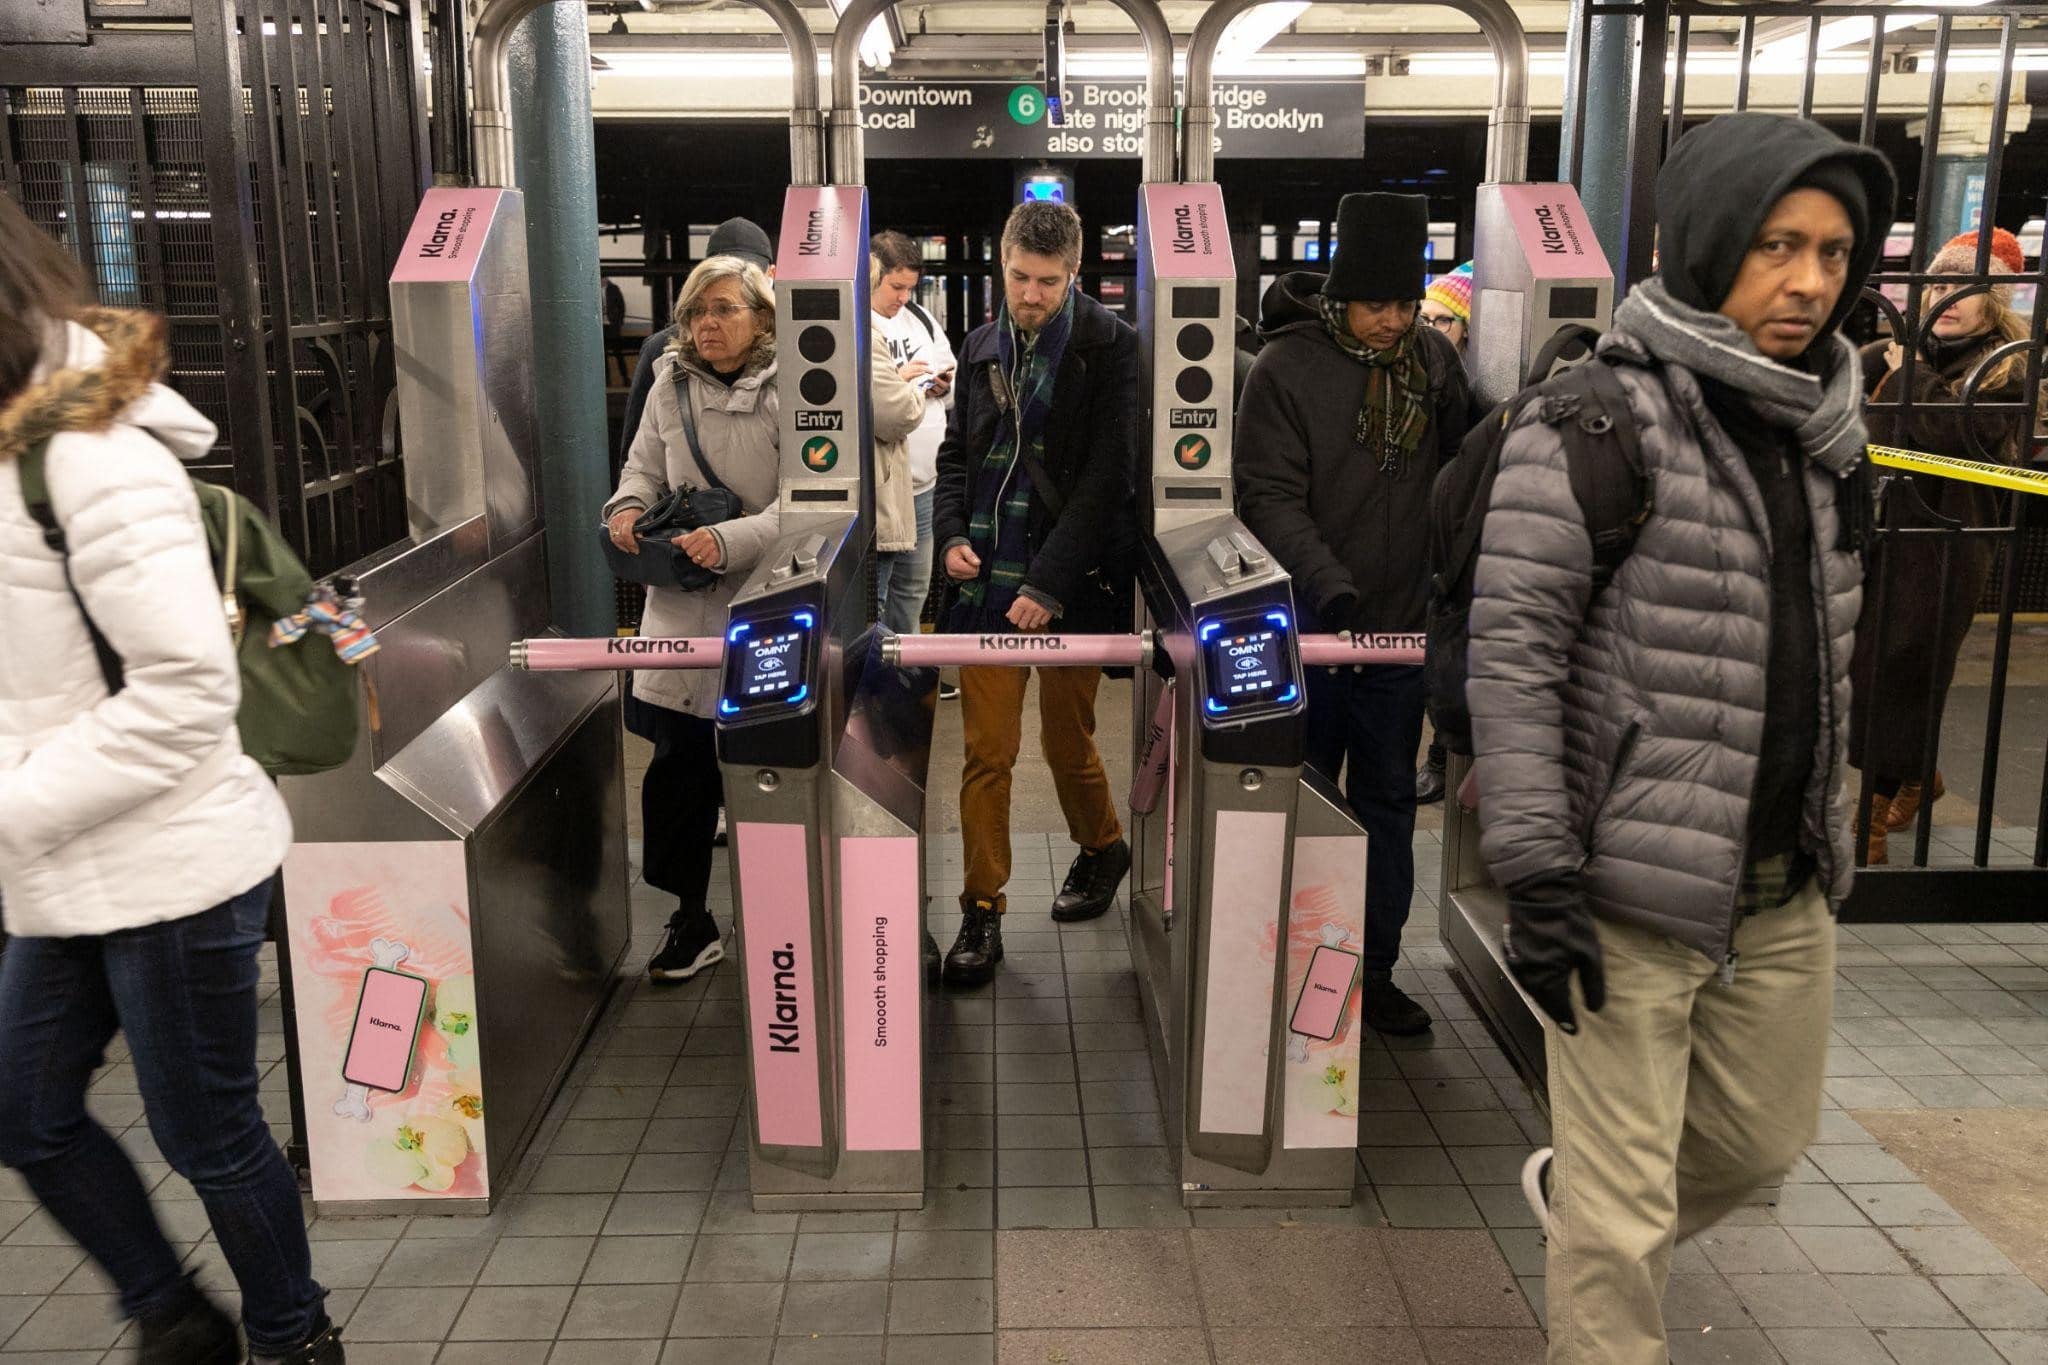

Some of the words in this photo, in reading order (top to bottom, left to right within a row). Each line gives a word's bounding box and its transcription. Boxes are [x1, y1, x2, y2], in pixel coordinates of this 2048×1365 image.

[860, 84, 972, 105] Downtown
[1018, 94, 1035, 117] 6
[1084, 85, 1182, 105] Brookn
[1211, 84, 1267, 110] ridge
[1227, 108, 1324, 133] Brooklyn
[1048, 132, 1094, 152] also
[418, 208, 459, 258] Klarna.
[1172, 204, 1196, 253] Klarna.
[1534, 204, 1568, 254] Klarna.
[797, 411, 841, 430] Entry
[1171, 409, 1216, 428] Entry
[607, 638, 695, 654] Klarna.
[755, 643, 791, 658] OMNY
[979, 635, 1067, 650] Klarna.
[1228, 642, 1266, 657] OMNY
[873, 916, 889, 982] shopping
[769, 942, 801, 1053] Klarna.
[874, 984, 888, 1048] Smoooth
